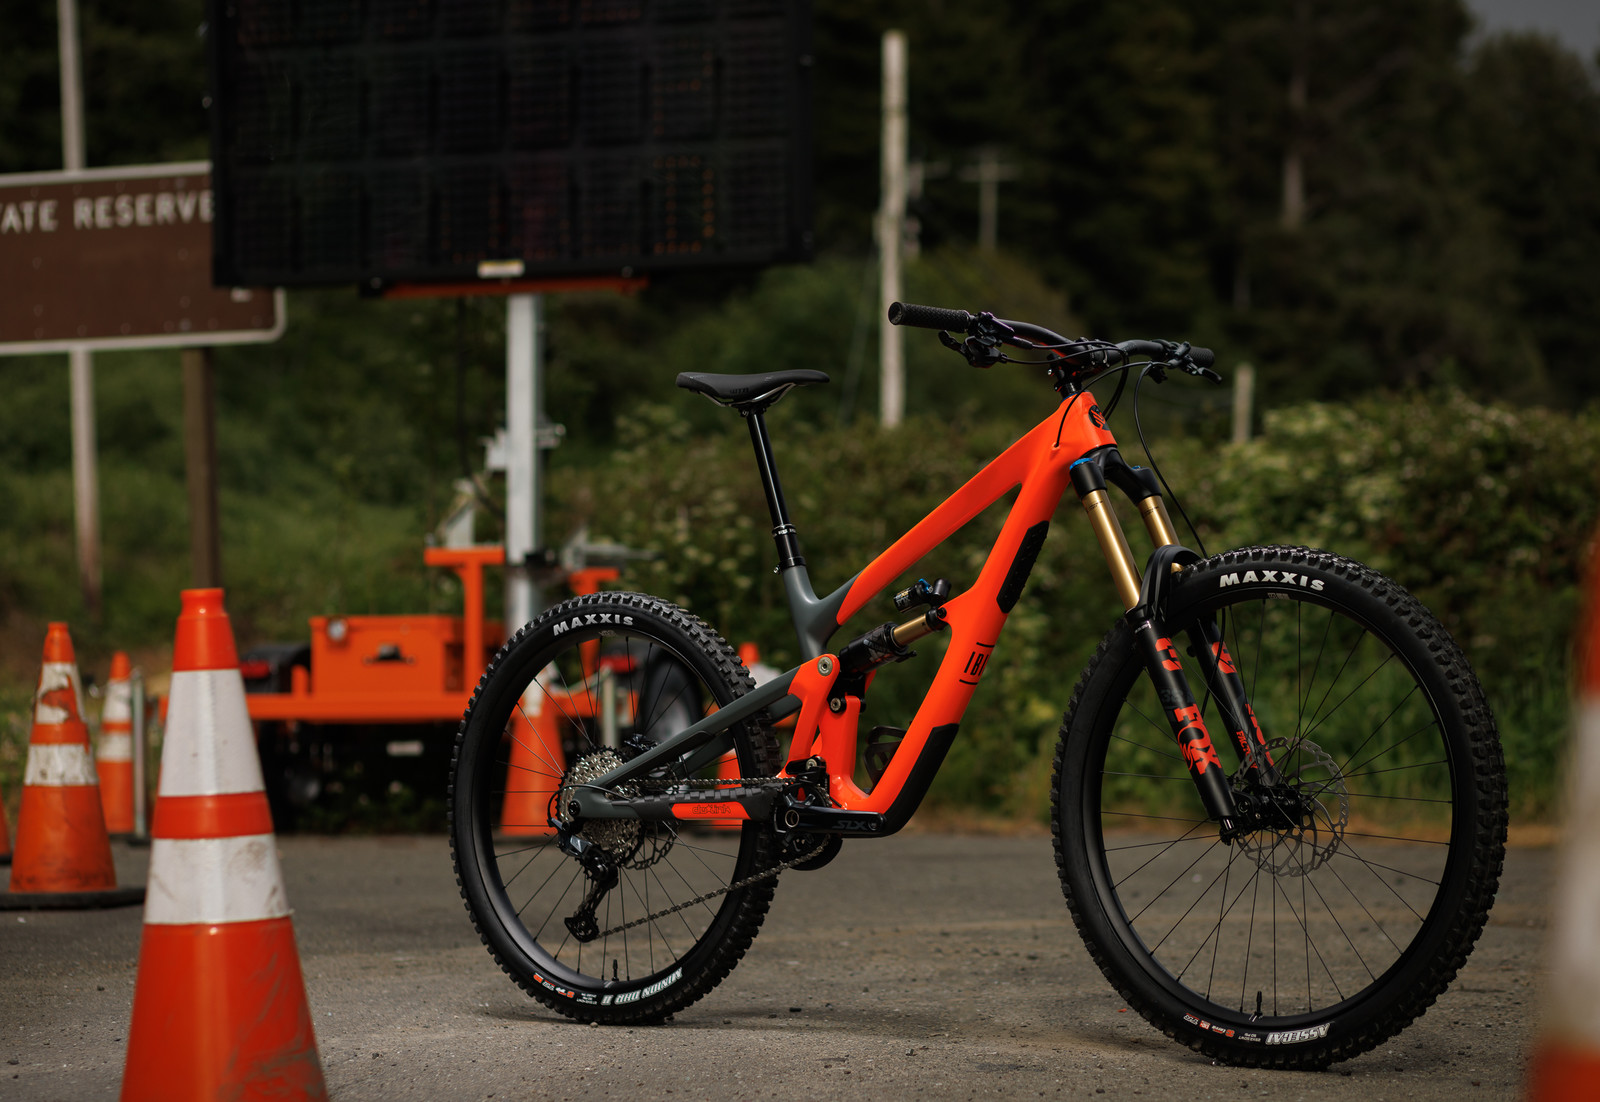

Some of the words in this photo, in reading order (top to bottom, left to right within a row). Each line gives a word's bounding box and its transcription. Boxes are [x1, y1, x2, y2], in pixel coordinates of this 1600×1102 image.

[0, 199, 58, 234] ATE
[73, 189, 214, 230] RESERVE
[1219, 570, 1325, 591] MAXXIS
[552, 613, 633, 636] MAXXIS
[831, 819, 868, 832] SLX
[641, 966, 683, 998] MINION
[614, 989, 641, 1005] DHR
[1264, 1022, 1331, 1046] ASSEGAI
